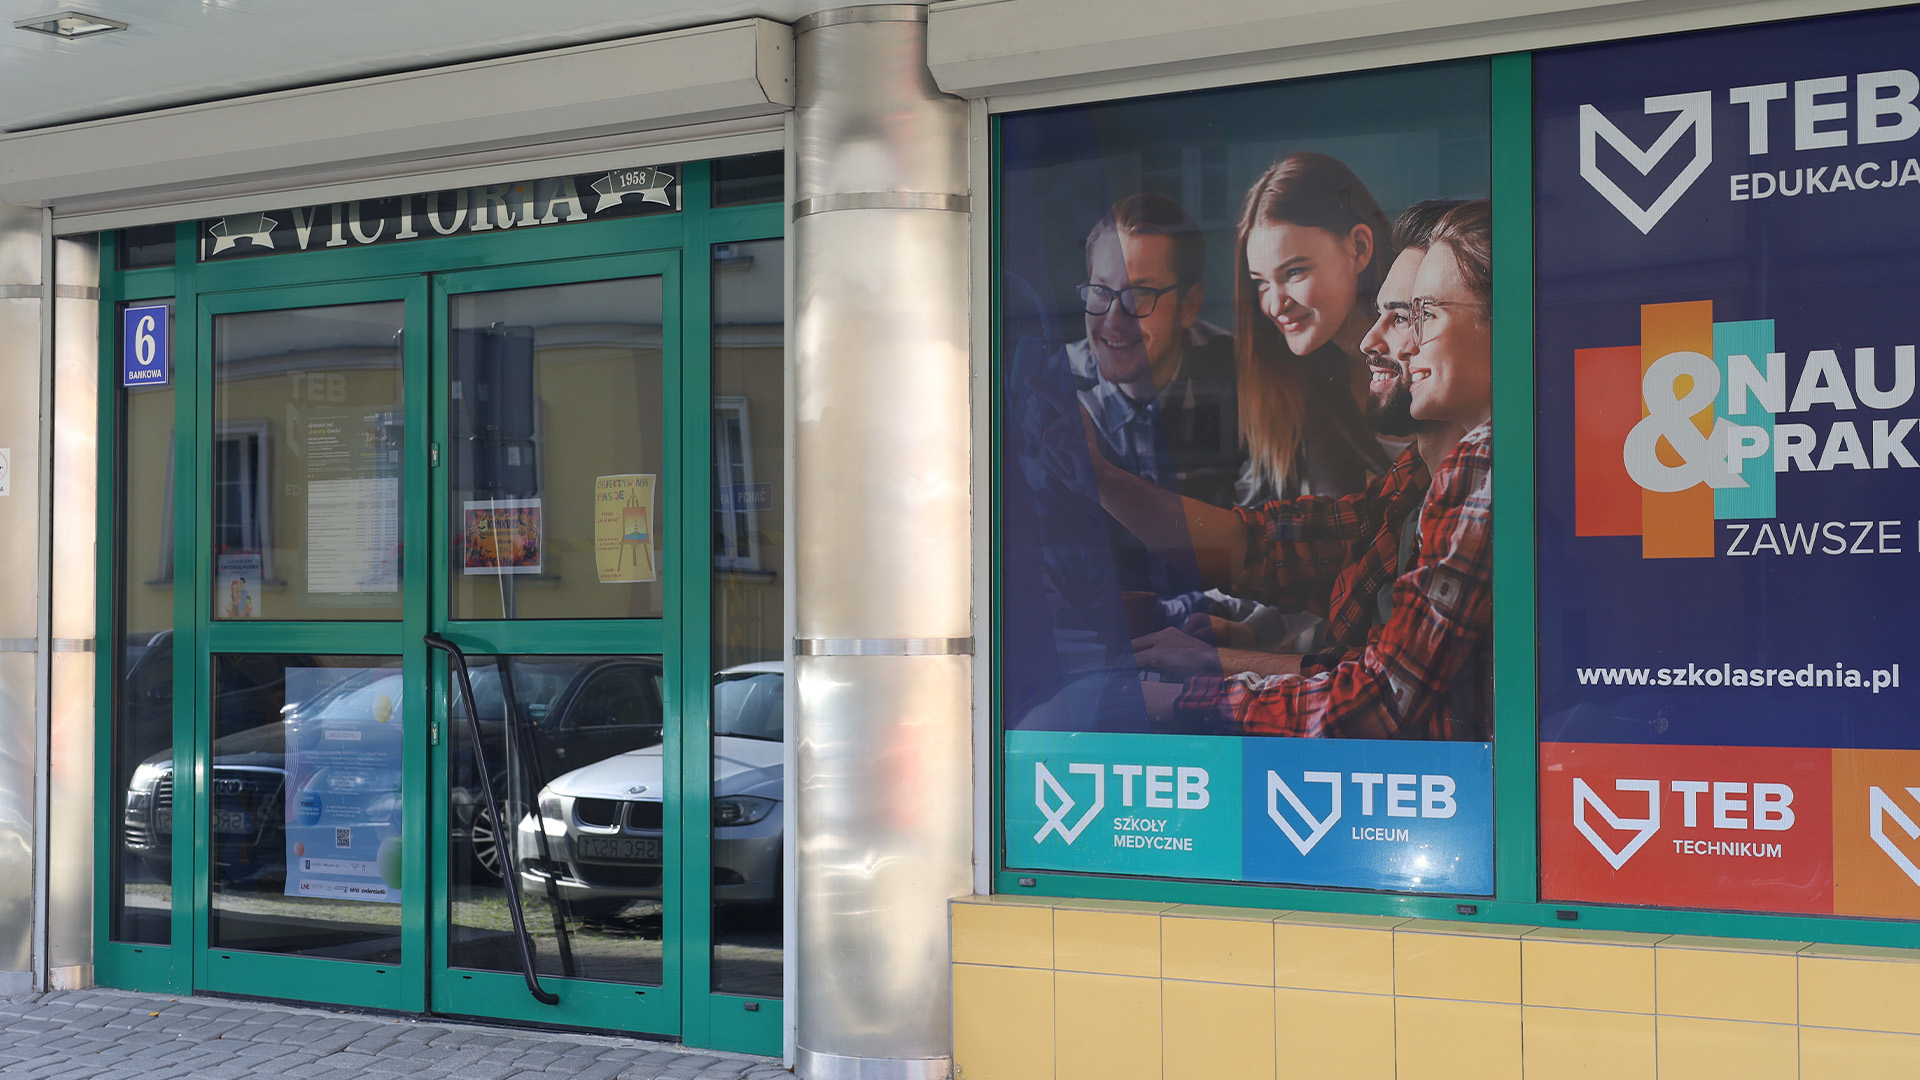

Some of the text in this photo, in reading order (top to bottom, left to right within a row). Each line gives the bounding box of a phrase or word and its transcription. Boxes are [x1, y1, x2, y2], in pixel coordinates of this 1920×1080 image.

[1729, 69, 1920, 156] TEB
[620, 170, 646, 189] 1958
[1730, 158, 1920, 201] EDUKACJA
[135, 315, 156, 366] 6
[128, 368, 162, 380] BANKOWA
[1623, 351, 1750, 493] &
[1727, 418, 1920, 474] PRAK
[1726, 520, 1902, 557] ZAWSZE
[1576, 662, 1900, 694] www.szkolasrednia.pl
[1113, 764, 1210, 810] TEB
[1351, 773, 1457, 818] TEB
[1671, 780, 1796, 831] TEB
[1113, 817, 1168, 834] SZKOŁY
[1113, 834, 1193, 851] MEDYCZNE
[1351, 826, 1409, 842] LICEUM
[1672, 839, 1782, 858] TECHNIKUM
